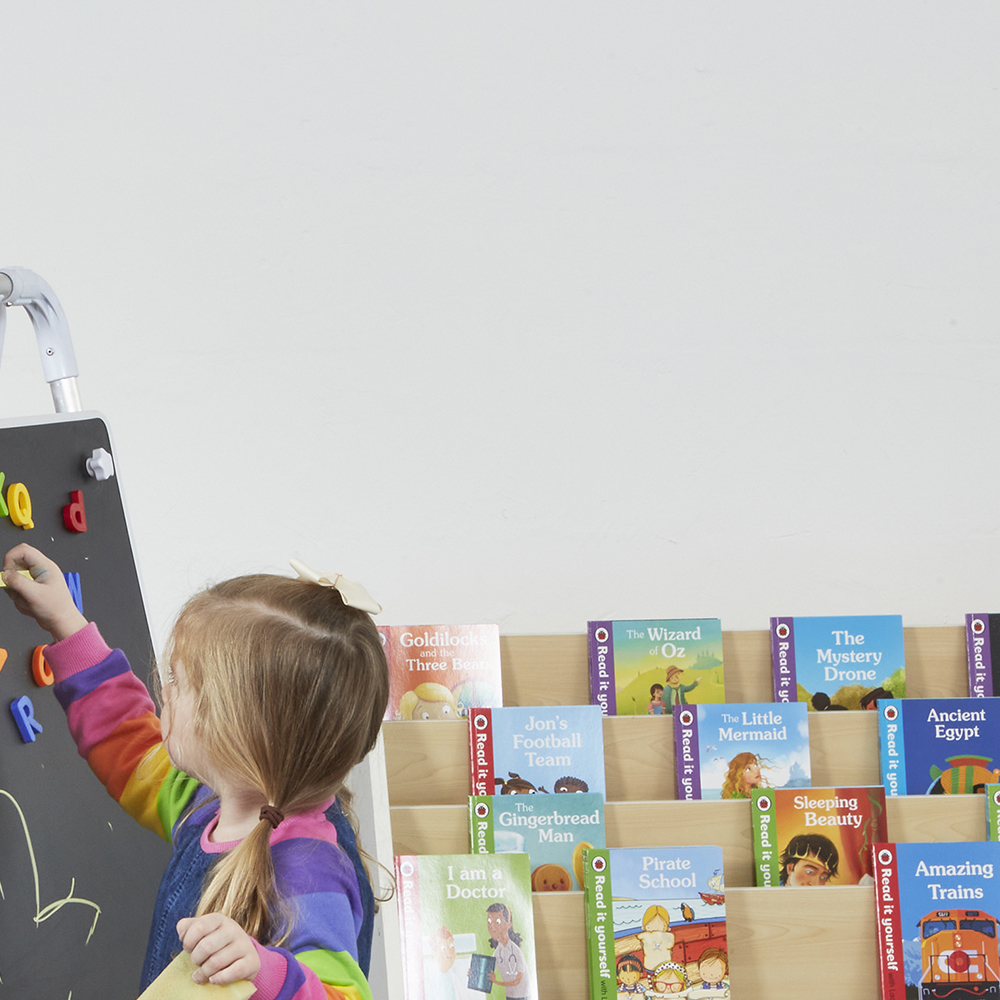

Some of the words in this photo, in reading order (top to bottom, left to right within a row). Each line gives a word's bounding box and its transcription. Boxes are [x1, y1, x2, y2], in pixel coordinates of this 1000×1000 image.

[400, 632, 487, 648] Goldilocks
[626, 629, 645, 639] The
[647, 626, 702, 641] Wizard
[831, 630, 866, 645] The
[419, 648, 437, 657] and
[439, 648, 455, 657] the
[649, 646, 659, 656] of
[661, 642, 686, 658] Oz
[779, 642, 791, 674] Read
[816, 649, 882, 666] Mystery
[973, 637, 985, 670] Read
[406, 659, 447, 671] Three
[452, 658, 491, 671] Bears
[597, 646, 609, 678] Read
[780, 677, 791, 687] it
[824, 667, 877, 681] Drone
[975, 673, 986, 682] it
[599, 681, 610, 691] it
[525, 715, 568, 731] Jon's
[721, 713, 740, 723] The
[741, 711, 783, 726] Little
[927, 708, 986, 722] Ancient
[513, 732, 582, 749] Football
[718, 726, 787, 742] Mermaid
[887, 724, 899, 756] Read
[935, 724, 980, 741] Egypt
[476, 733, 488, 766] Read
[682, 729, 694, 762] Read
[524, 752, 572, 767] Team
[888, 760, 900, 770] it
[478, 769, 489, 779] it
[684, 765, 695, 775] it
[515, 803, 534, 812] The
[793, 795, 859, 811] Sleeping
[499, 809, 600, 829] Gingerbread
[804, 812, 862, 828] Beauty
[478, 821, 490, 854] Read
[538, 828, 574, 843] Man
[760, 815, 772, 848] Read
[642, 856, 691, 871] Pirate
[762, 851, 773, 861] it
[447, 866, 453, 881] I
[460, 869, 487, 881] am
[492, 869, 503, 880] a
[915, 861, 994, 878] Amazing
[639, 872, 697, 889] School
[881, 868, 893, 902] Read
[402, 881, 415, 914] Read
[446, 884, 506, 899] Doctor
[595, 876, 607, 909] Read
[928, 884, 984, 900] Trains
[597, 912, 608, 922] it
[884, 905, 895, 914] it
[595, 925, 611, 979] yourself
[881, 918, 899, 971] yourself
